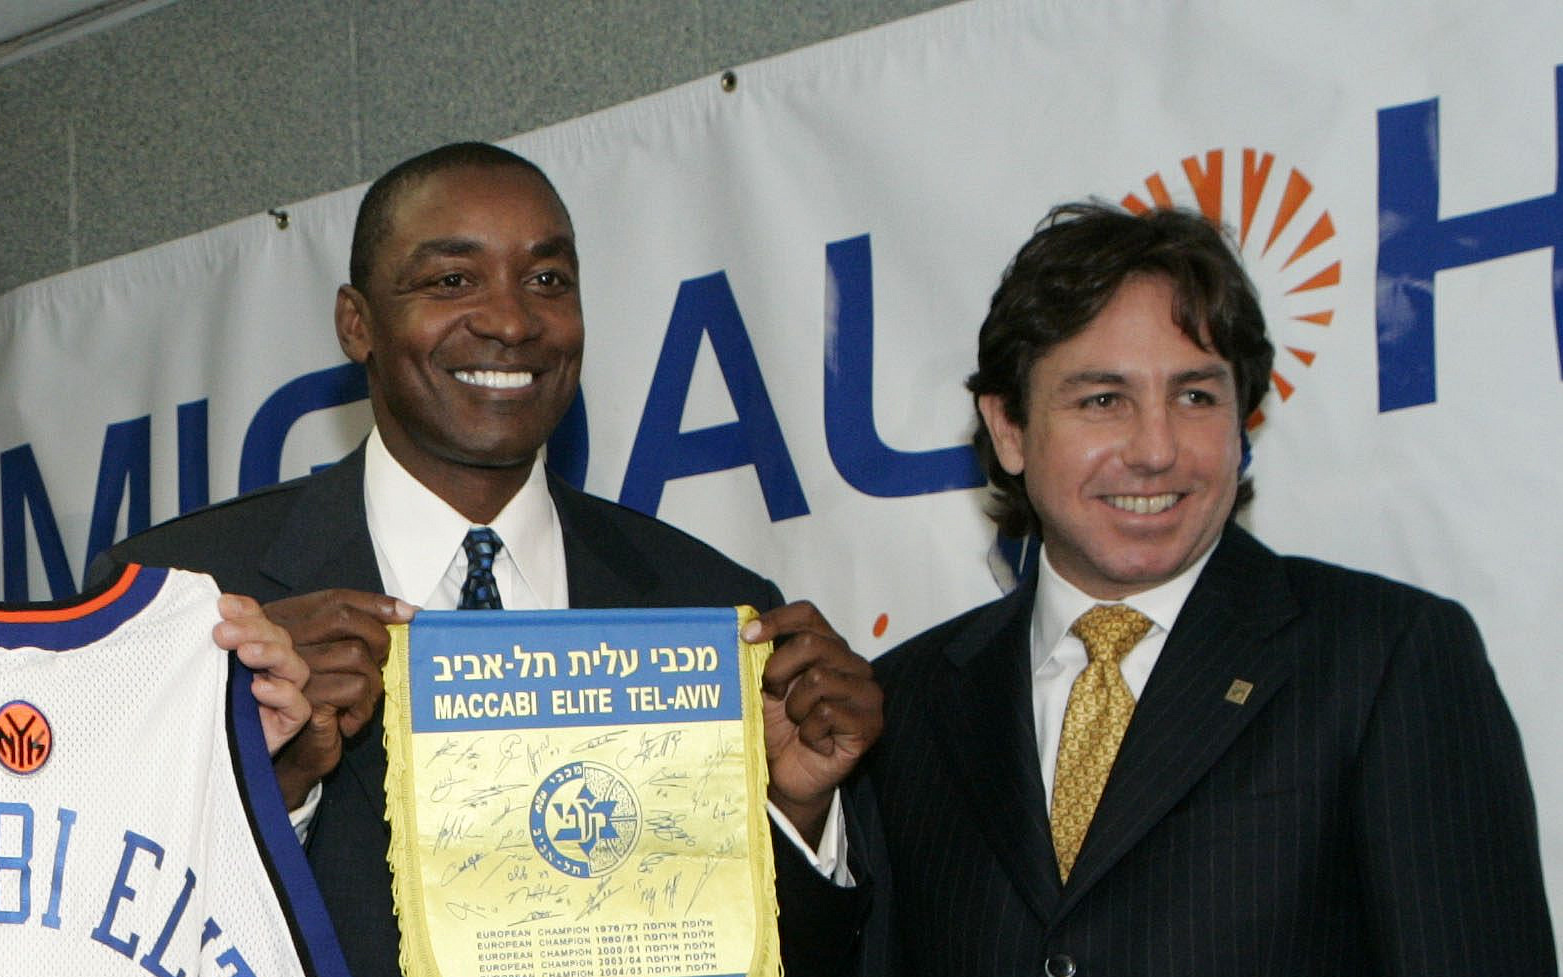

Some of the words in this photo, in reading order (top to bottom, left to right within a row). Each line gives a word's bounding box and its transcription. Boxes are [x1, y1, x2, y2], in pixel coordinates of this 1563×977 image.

[433, 645, 557, 681] תל-אביב
[568, 642, 638, 678] עלית
[651, 646, 718, 673] מכבי
[435, 691, 537, 720] MACCABI
[552, 688, 612, 715] ELITE
[626, 684, 721, 712] TEL-AVIV
[477, 930, 530, 939] EUROPEAN
[538, 926, 590, 936] CHAMPION
[478, 941, 532, 950] EUROPEAN
[539, 937, 591, 946] CHAMPION
[478, 952, 533, 961] EUROPEAN
[540, 948, 592, 958] CHAMPION
[480, 963, 534, 972] EUROPEAN
[541, 959, 593, 969] CHAMPION
